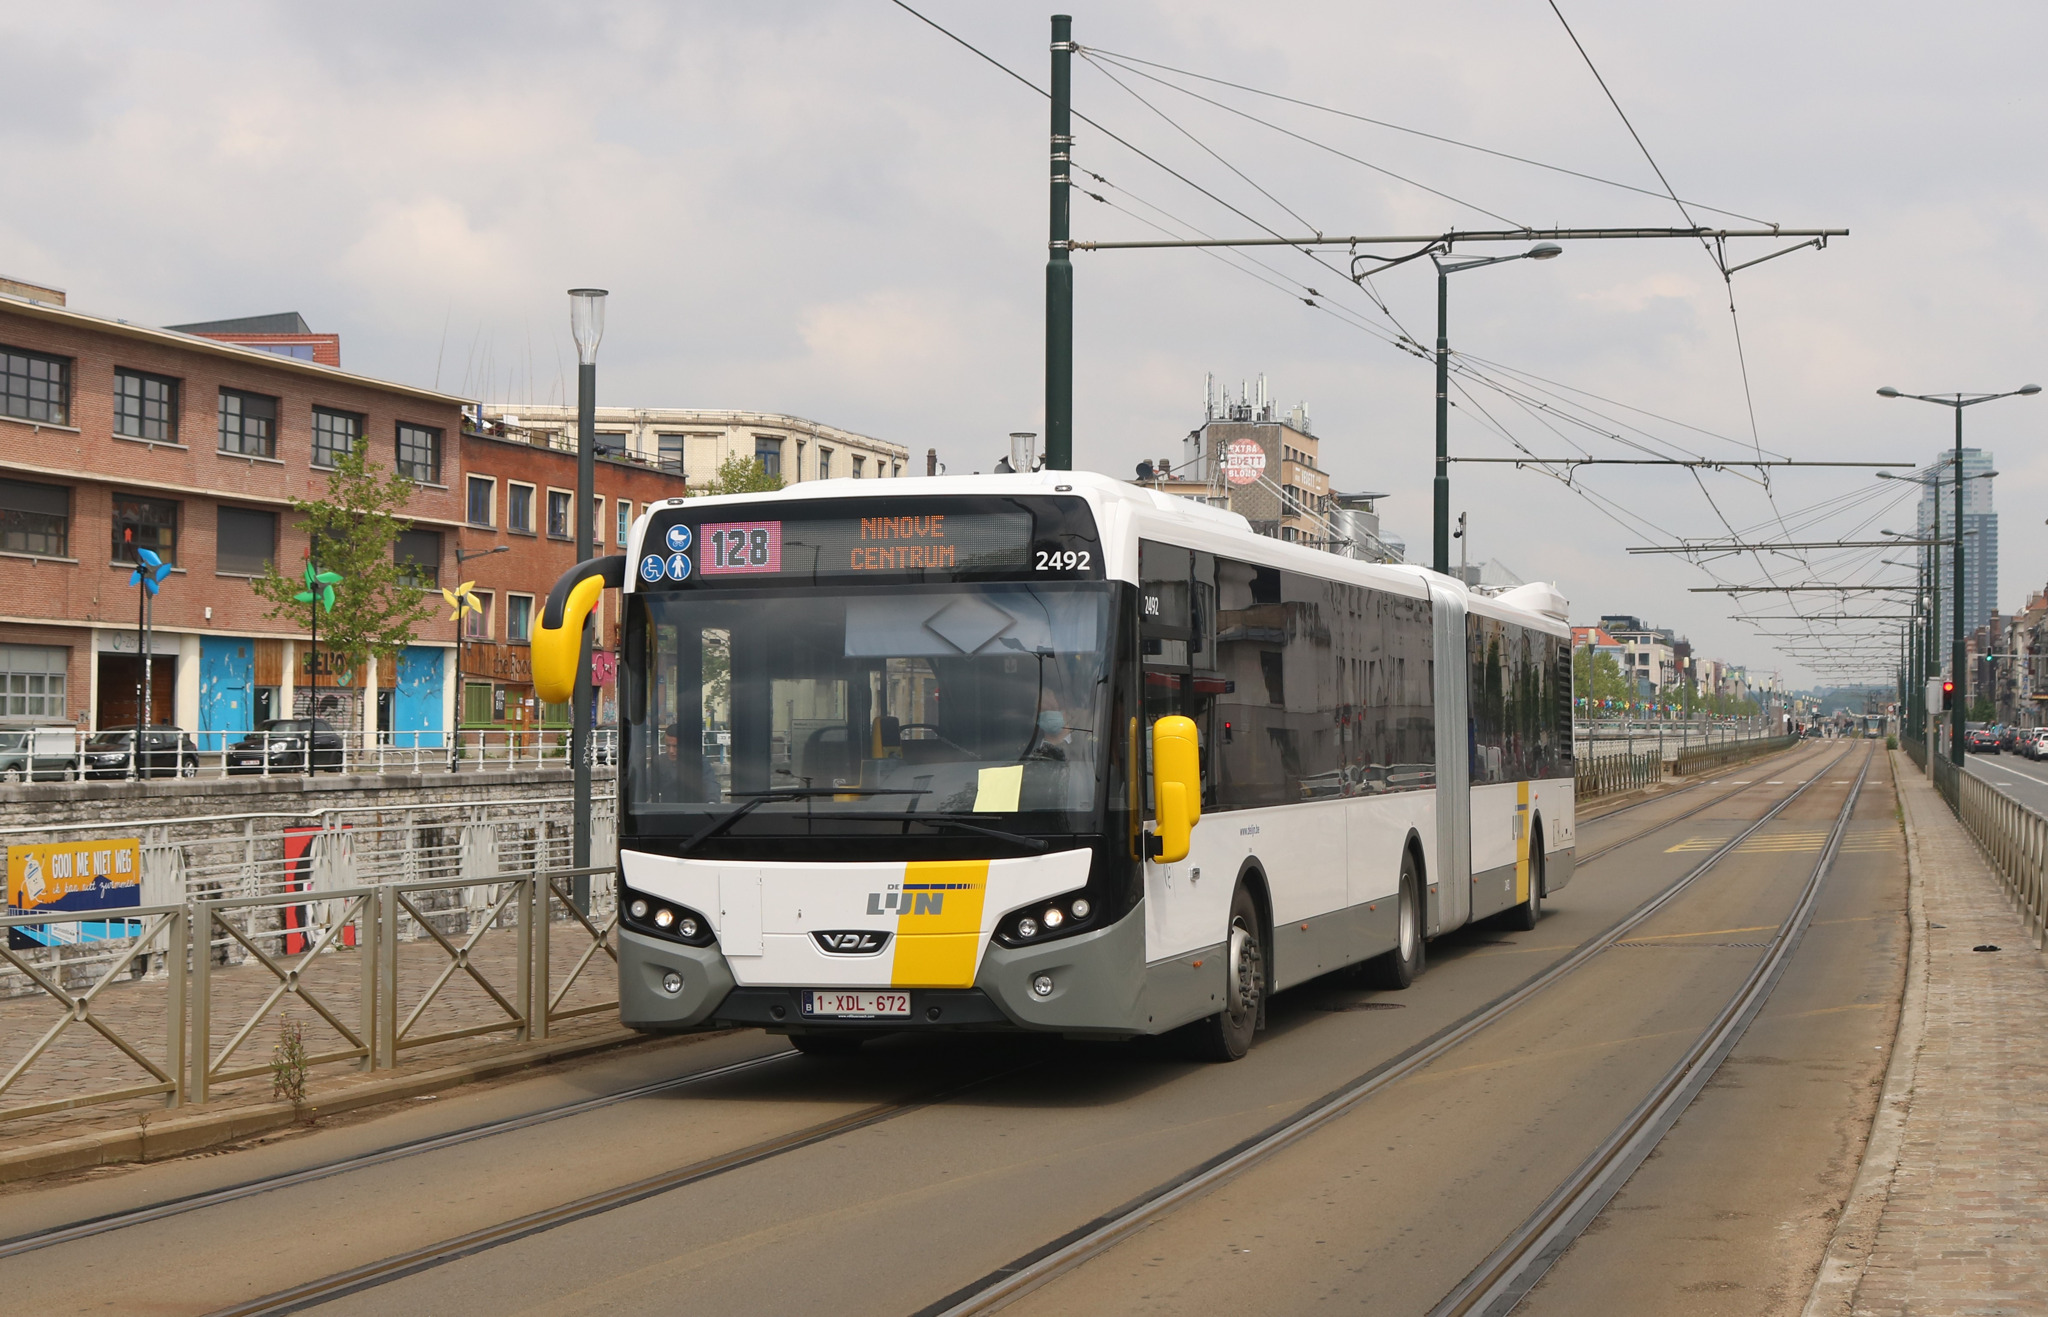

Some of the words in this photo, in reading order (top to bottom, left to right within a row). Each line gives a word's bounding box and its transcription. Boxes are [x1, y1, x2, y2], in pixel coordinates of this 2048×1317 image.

[1229, 444, 1257, 453] EXTRA
[1226, 456, 1262, 466] EDETT
[1228, 469, 1257, 477] BLOND
[861, 515, 944, 540] NINOVE
[711, 528, 770, 568] 128
[850, 545, 955, 570] CENTRUM
[1035, 551, 1090, 570] 2492
[1145, 596, 1159, 615] 2492
[52, 853, 72, 878] GOOI
[77, 852, 90, 877] ME
[93, 850, 111, 875] NIET
[115, 849, 132, 874] WEG
[822, 934, 877, 948] VDL
[806, 1003, 812, 1012] B
